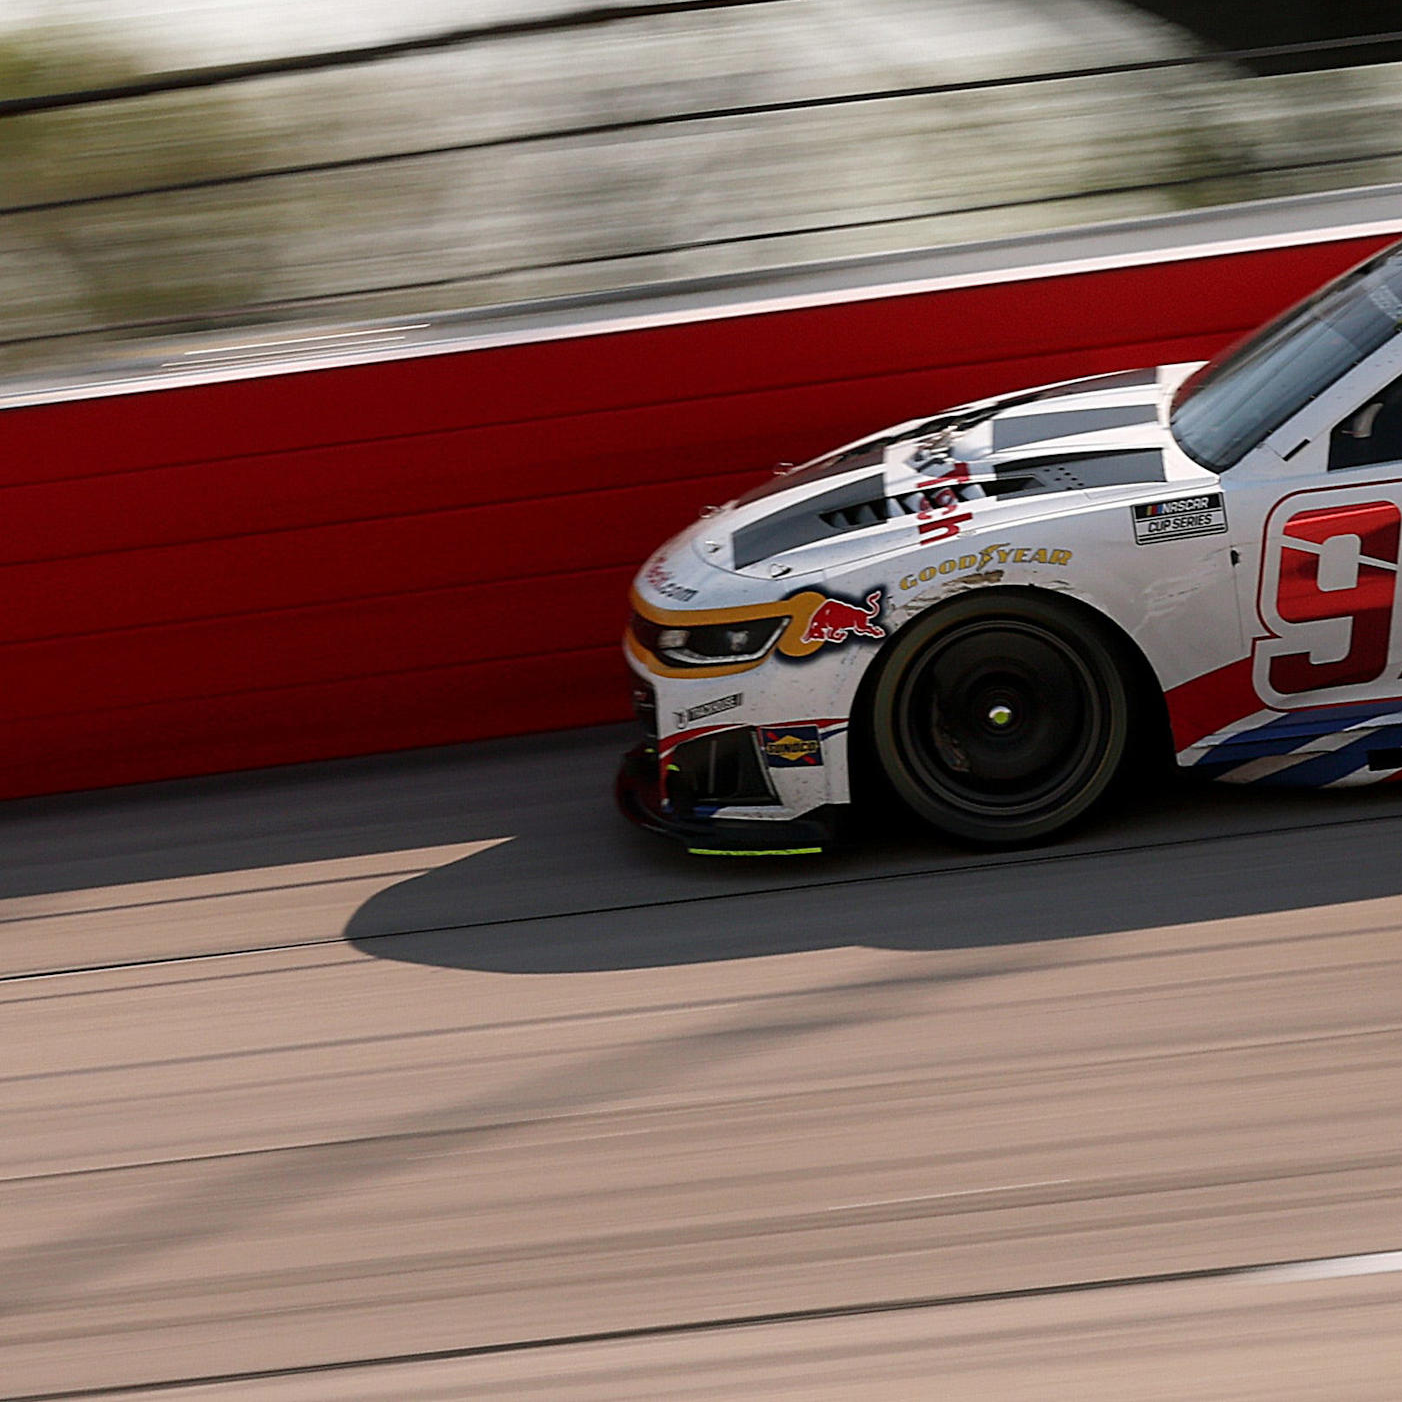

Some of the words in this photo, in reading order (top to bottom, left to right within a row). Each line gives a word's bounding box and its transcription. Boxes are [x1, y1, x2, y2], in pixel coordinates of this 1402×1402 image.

[1162, 497, 1210, 514] NASCAR
[1148, 519, 1171, 532] CUP
[1172, 514, 1212, 529] SERIES
[900, 546, 1073, 591] GOODYEAR
